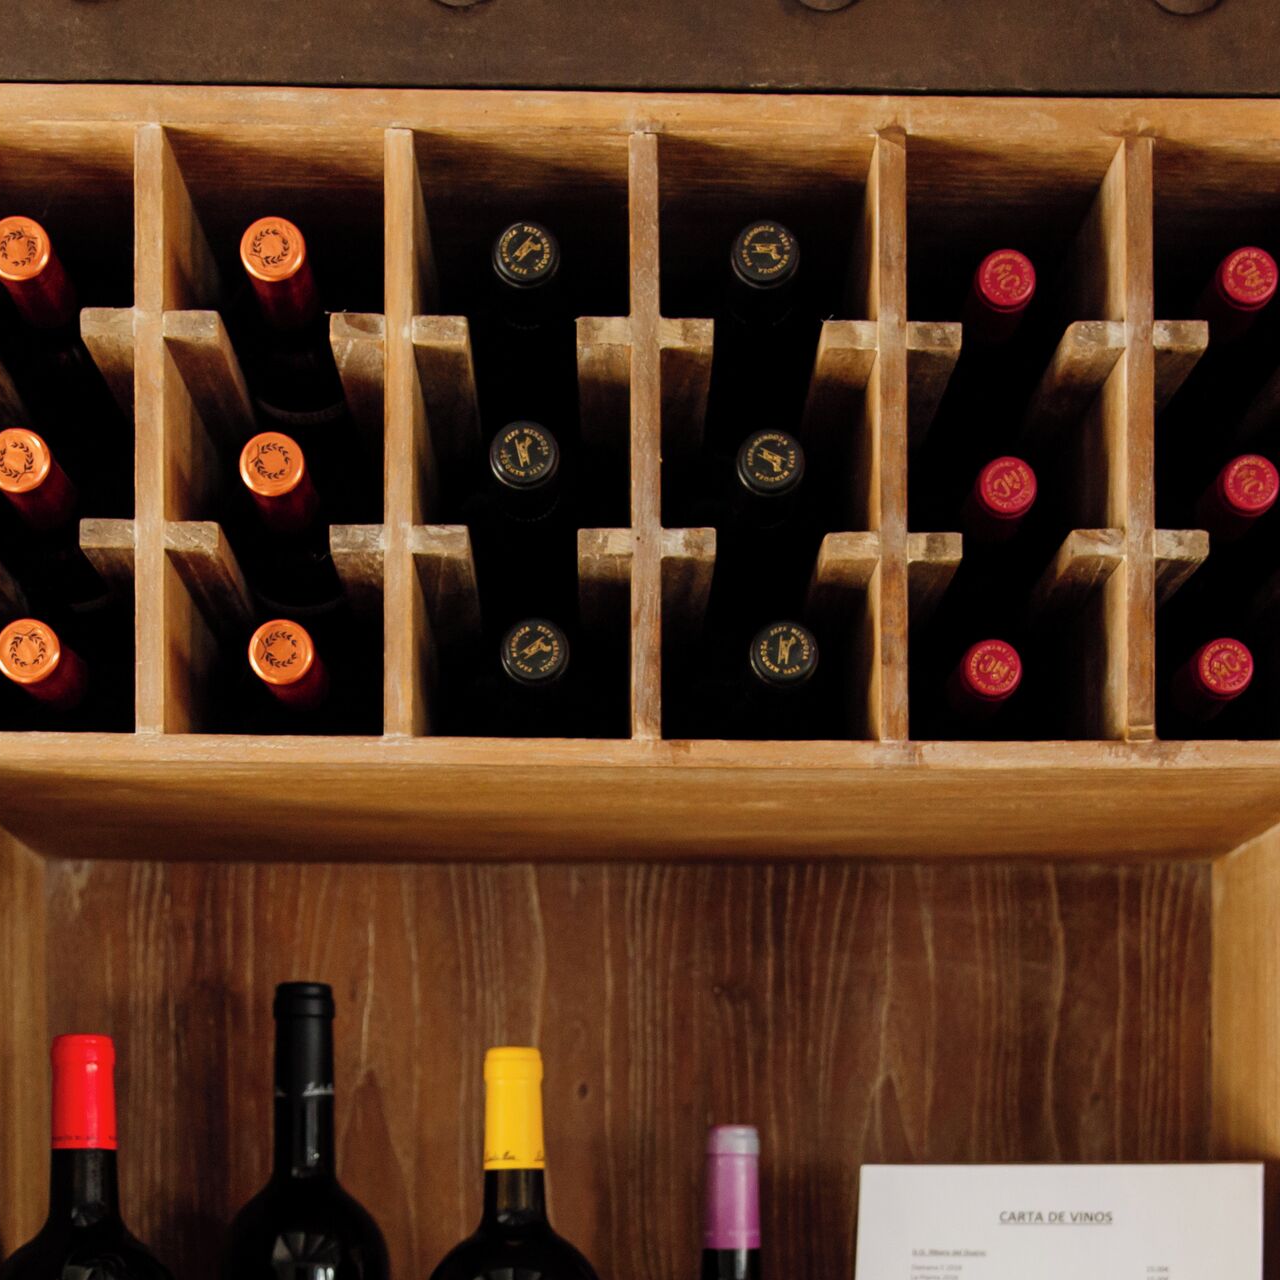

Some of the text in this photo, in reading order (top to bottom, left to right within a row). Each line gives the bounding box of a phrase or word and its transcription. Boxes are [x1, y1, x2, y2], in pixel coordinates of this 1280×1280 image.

[999, 1210, 1112, 1222] CARTA DE VINOS
